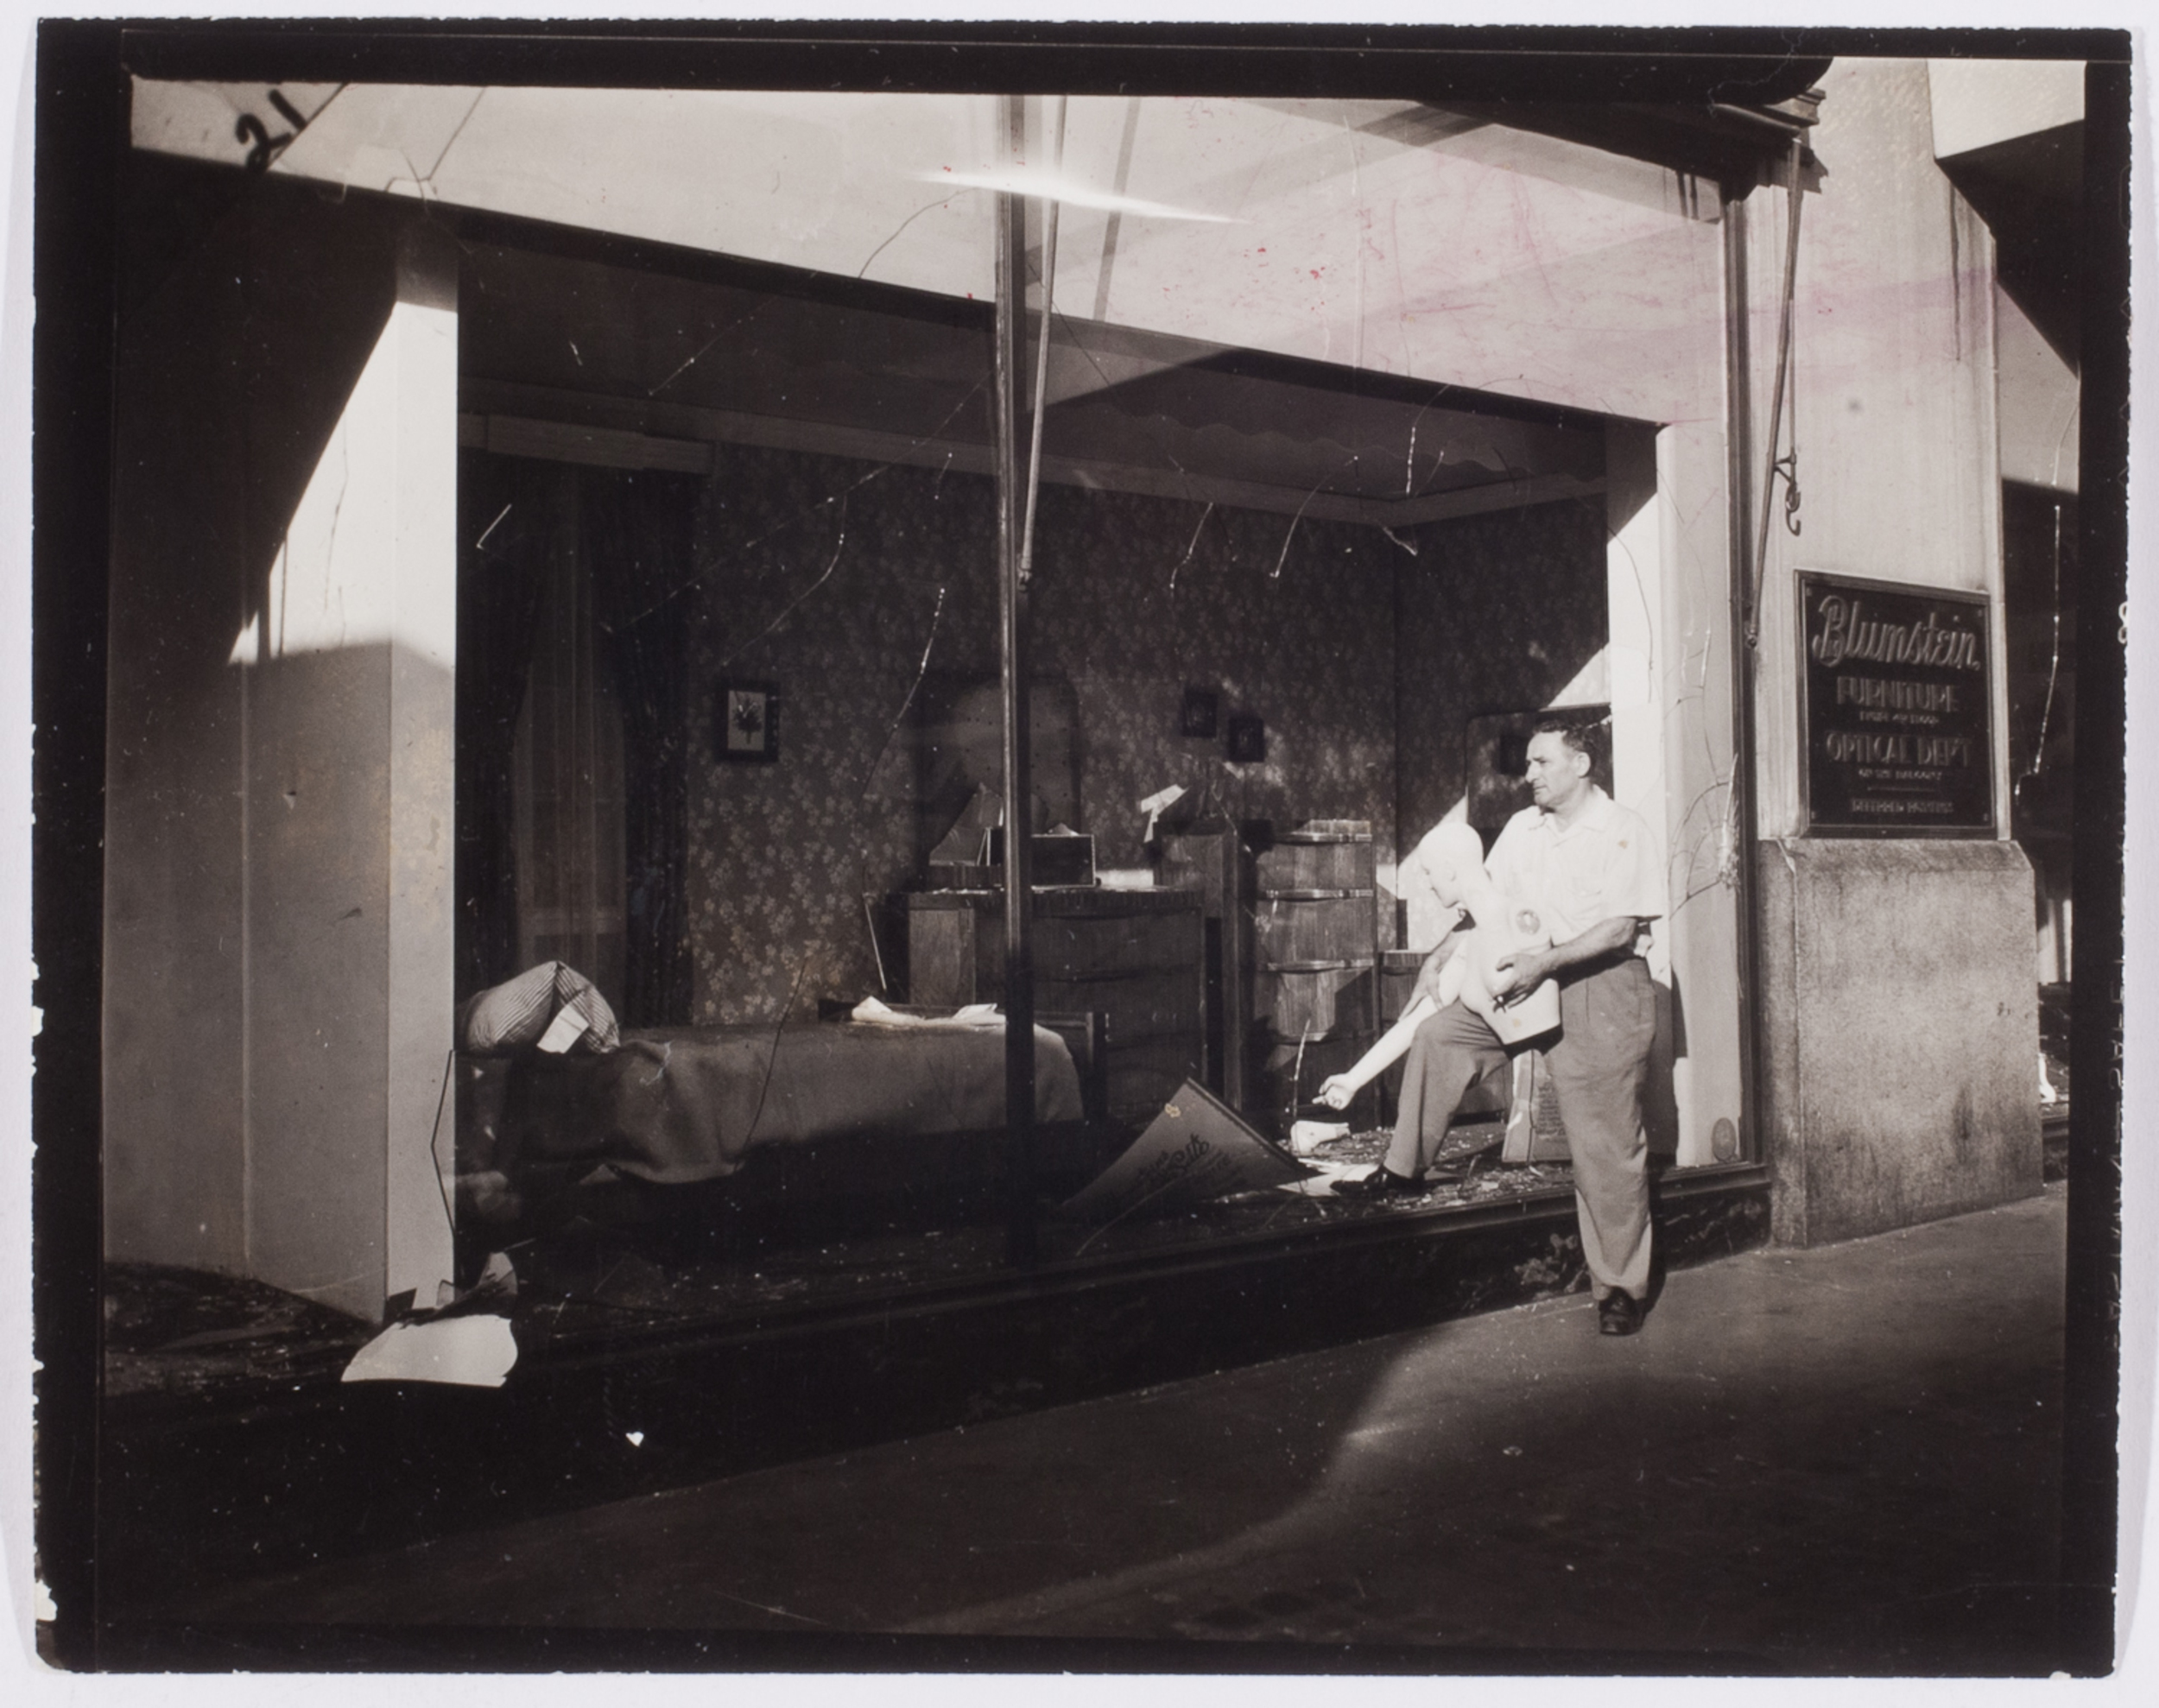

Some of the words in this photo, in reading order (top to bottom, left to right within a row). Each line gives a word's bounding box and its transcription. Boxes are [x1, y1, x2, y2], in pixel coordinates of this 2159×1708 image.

[1812, 594, 1981, 671] Blumstein
[1836, 676, 1960, 713] FURNITURE
[1826, 732, 1912, 764] OPTICAL
